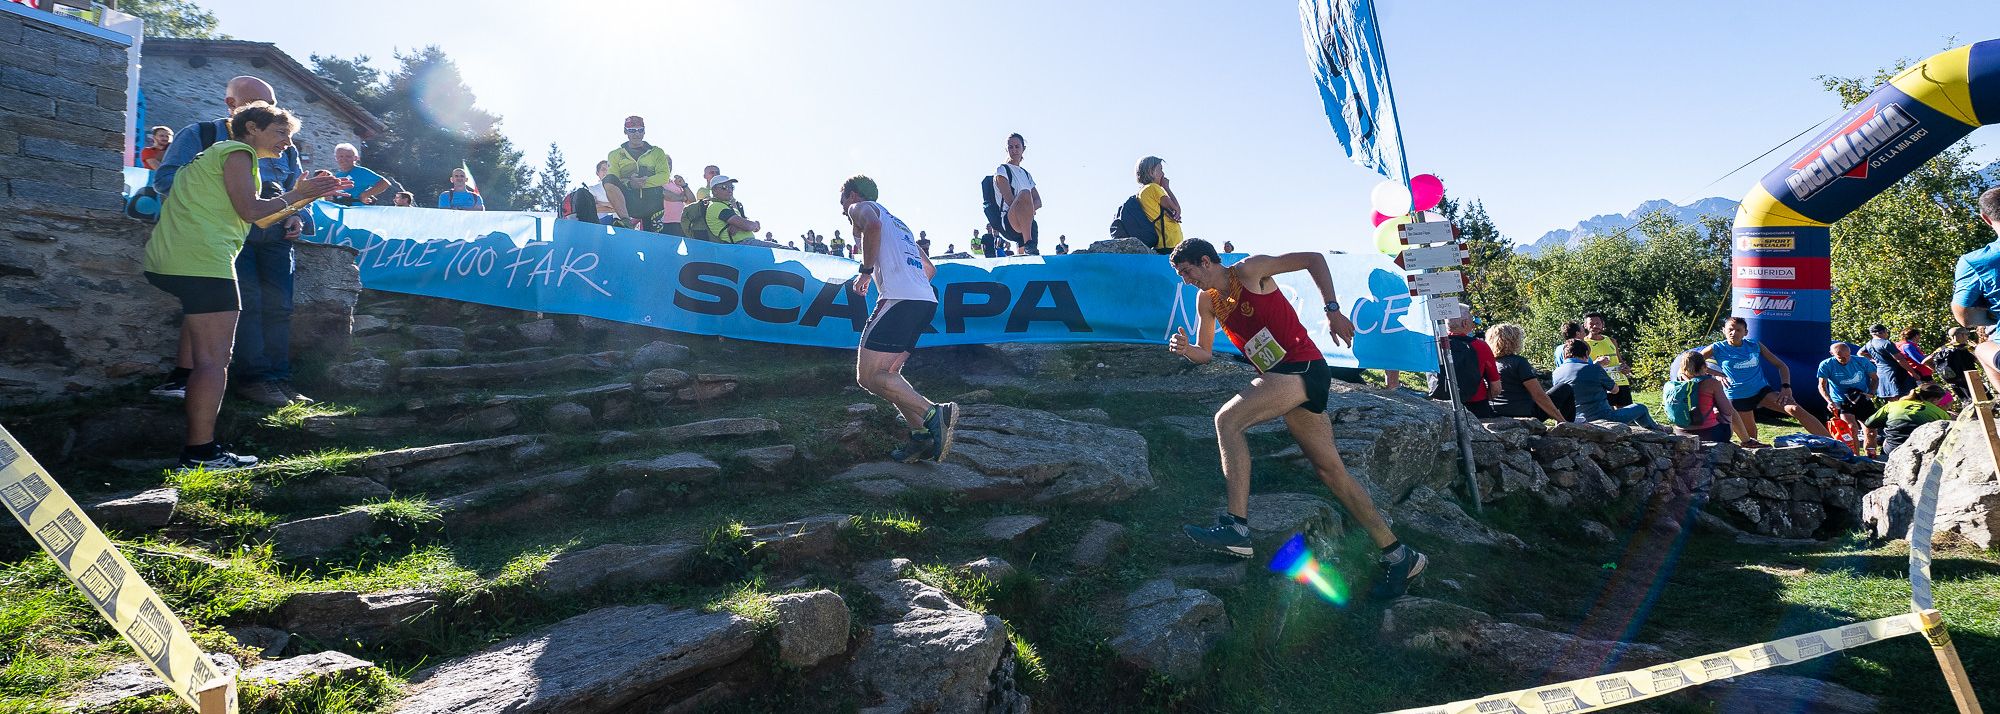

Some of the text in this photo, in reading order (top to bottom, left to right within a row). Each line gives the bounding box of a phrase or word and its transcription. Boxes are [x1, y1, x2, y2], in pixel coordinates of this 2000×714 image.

[1870, 128, 1929, 169] IO E LA MIA BICI
[358, 229, 442, 268] PLACE
[504, 240, 612, 297] FAR.
[1748, 268, 1794, 276] BLUFRIDA
[674, 261, 1093, 335] SCAPA
[1258, 347, 1276, 367] 30
